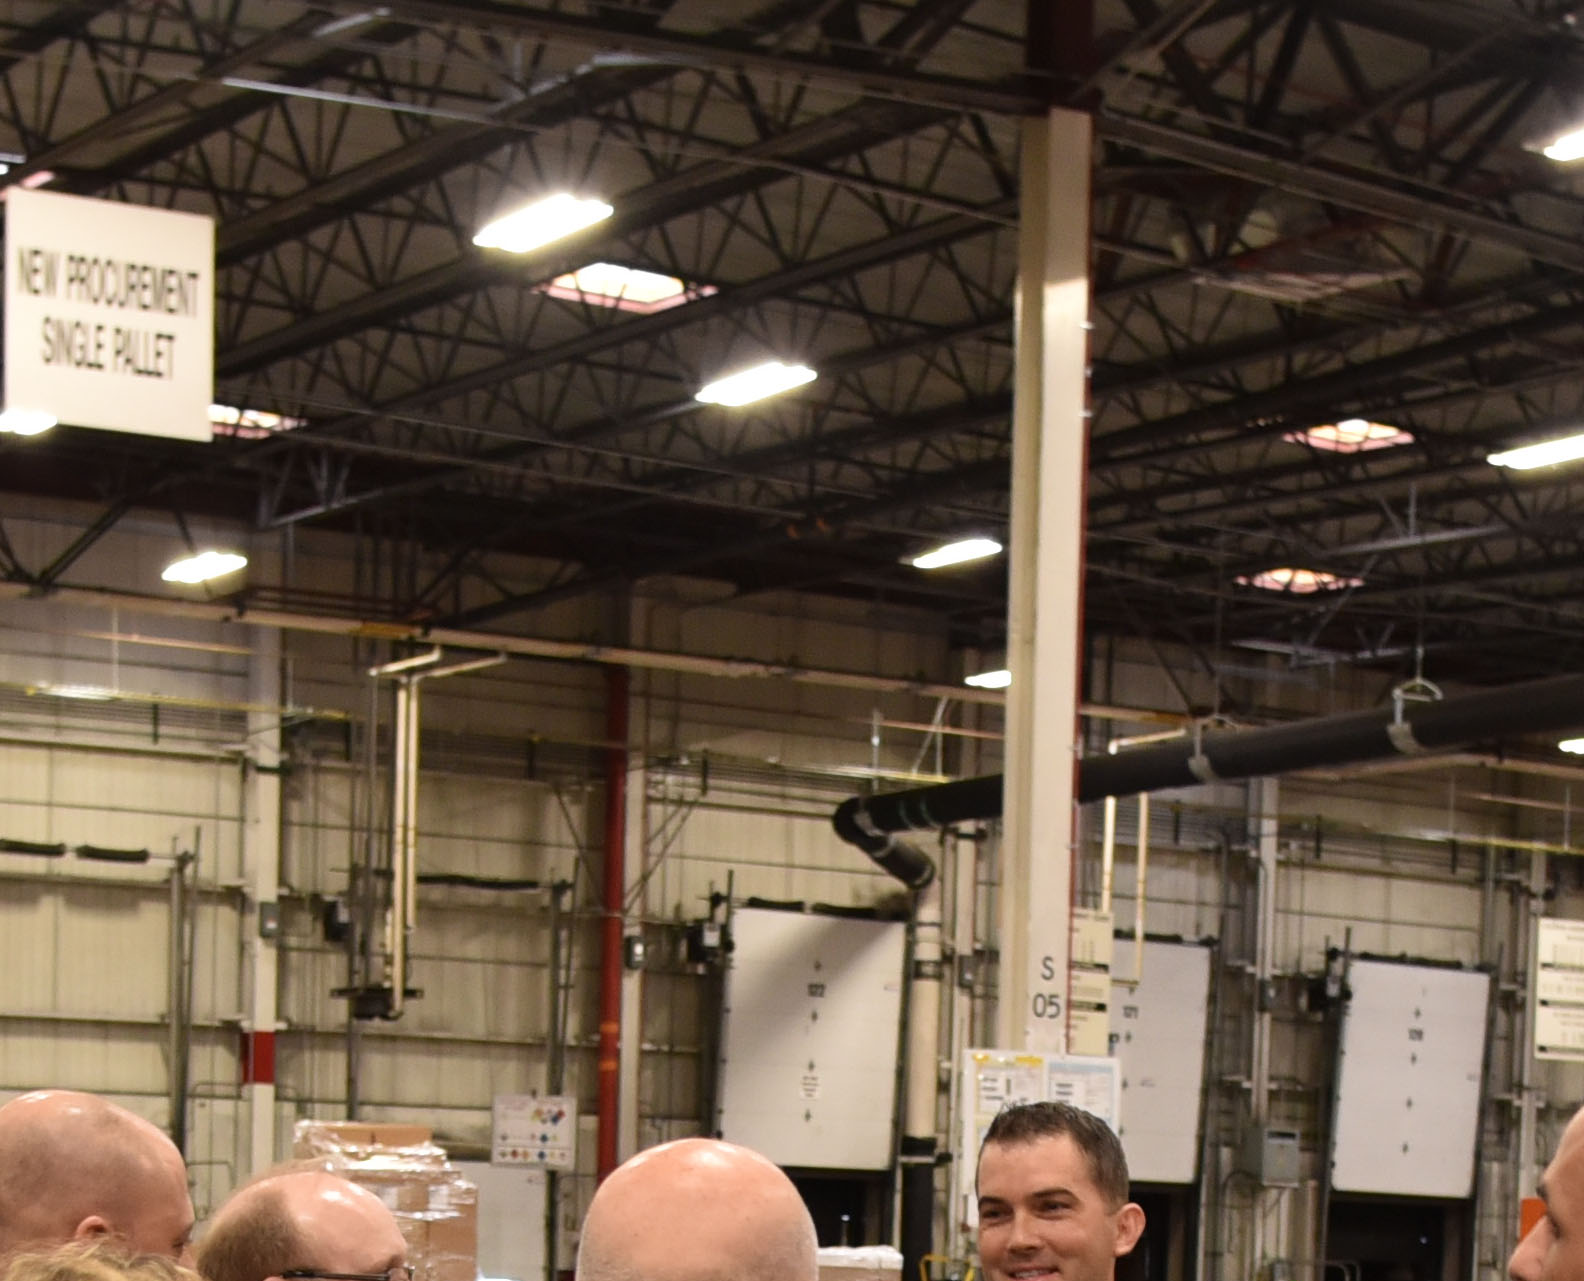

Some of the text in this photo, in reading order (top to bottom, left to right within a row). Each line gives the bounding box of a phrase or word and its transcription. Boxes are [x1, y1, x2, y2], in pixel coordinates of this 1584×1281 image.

[19, 247, 200, 318] NEW PROCUREMENT
[43, 315, 176, 381] SINGLE PALLET
[1040, 956, 1055, 981] S
[1032, 993, 1061, 1019] 05
